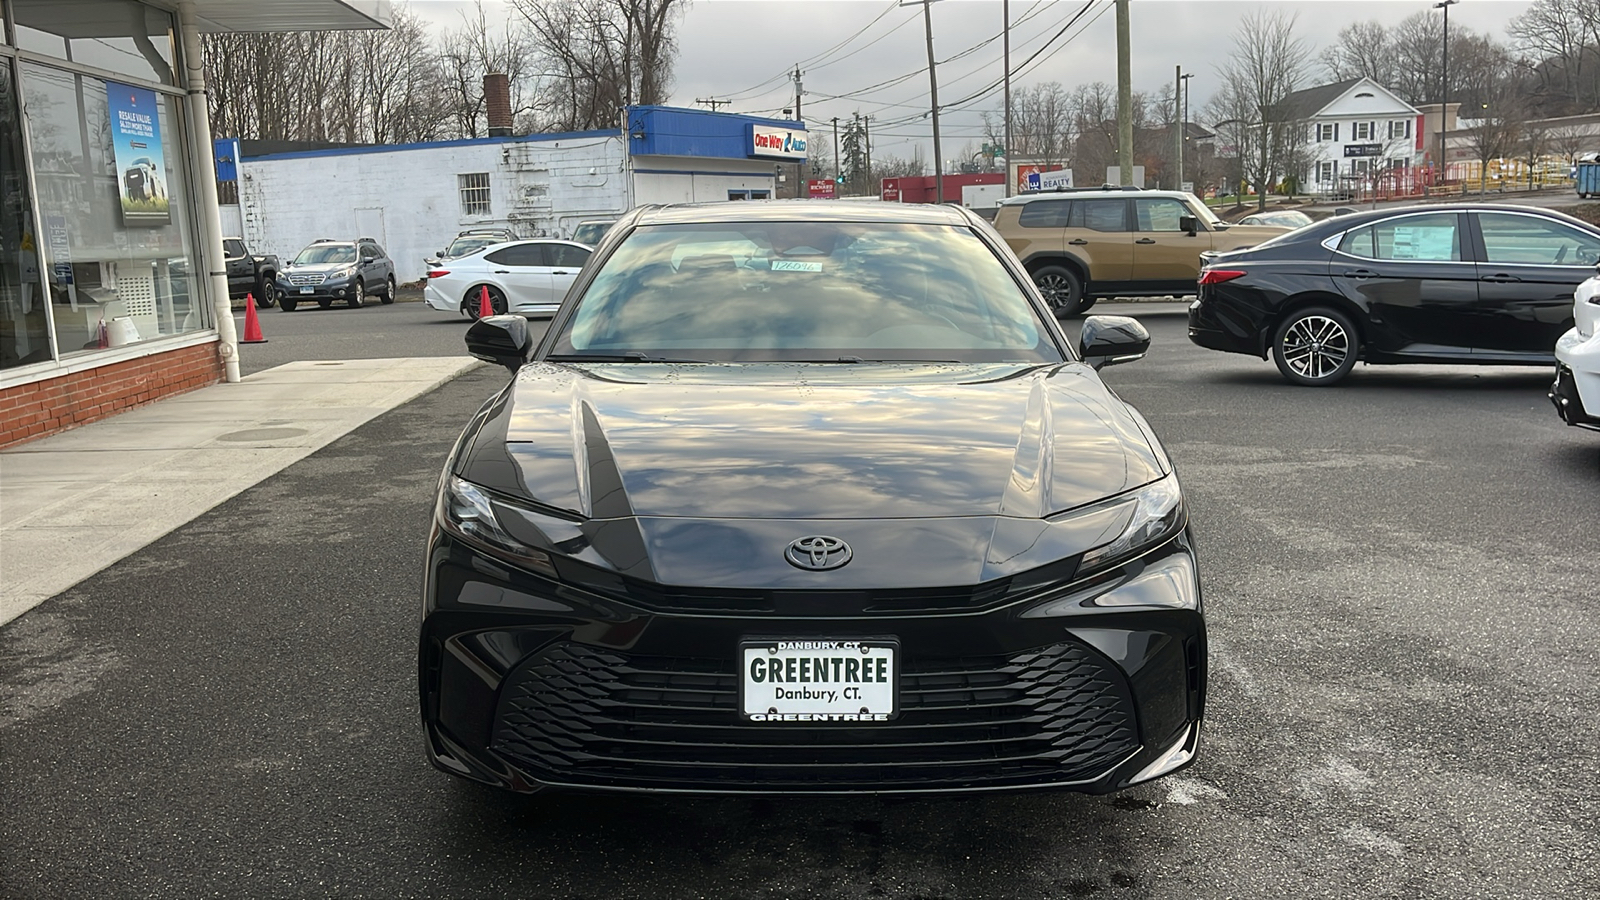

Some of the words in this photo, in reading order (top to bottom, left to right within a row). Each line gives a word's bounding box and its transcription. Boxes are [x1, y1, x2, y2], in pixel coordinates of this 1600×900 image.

[119, 110, 136, 122] RESALE
[755, 133, 769, 147] One
[769, 134, 784, 152] Way
[791, 137, 807, 152] Auto
[1044, 178, 1070, 188] REALTY
[778, 641, 841, 651] DANBURY,
[843, 641, 861, 651] CT
[750, 657, 888, 684] GREENTREE
[775, 686, 839, 703] Danbury,
[843, 687, 862, 701] CT.
[750, 713, 888, 722] GREENTREE
